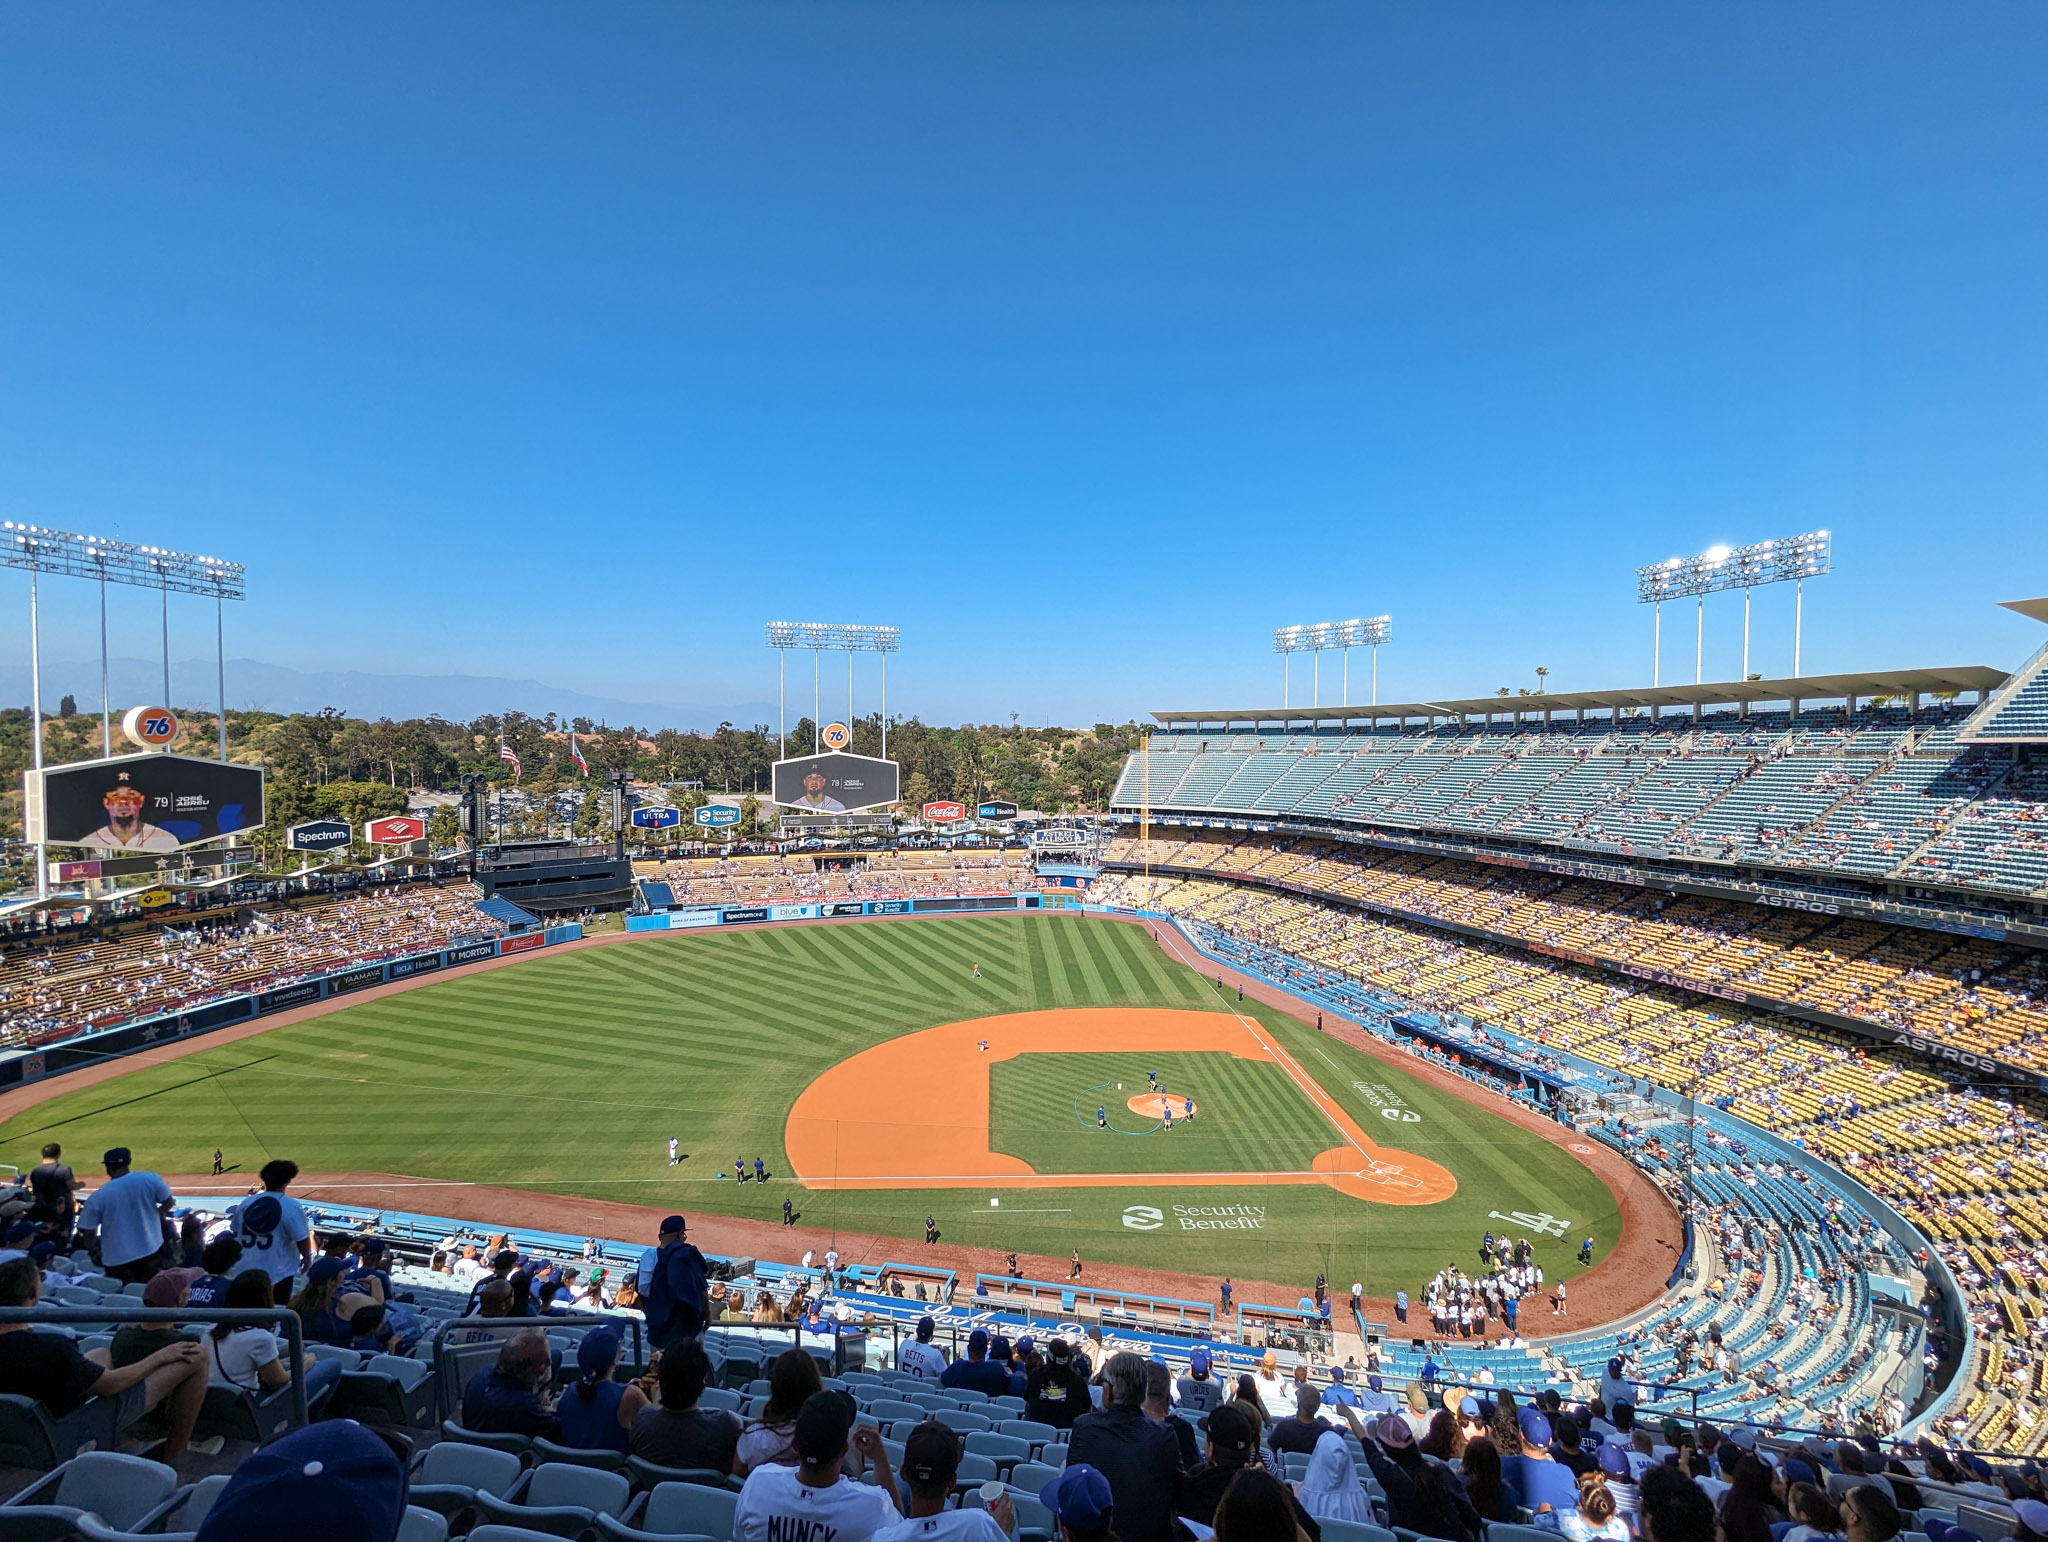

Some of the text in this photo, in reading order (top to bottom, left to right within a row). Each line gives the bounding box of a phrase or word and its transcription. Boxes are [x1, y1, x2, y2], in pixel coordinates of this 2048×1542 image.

[145, 718, 170, 736] 76
[829, 731, 844, 741] 76
[154, 797, 169, 808] 79
[642, 812, 670, 820] ULTRA
[712, 809, 736, 818] Security
[713, 815, 734, 823] Benefit
[298, 829, 346, 842] Spectrum
[1335, 835, 1363, 845] ASTROS
[1592, 845, 1618, 854] AMERICA
[1549, 865, 1646, 887] LOS ANGELES
[1279, 881, 1313, 895] ANGELES
[227, 897, 268, 908] ANGELES
[1359, 902, 1392, 915] ASTROS
[1755, 894, 1840, 915] ASTROS
[780, 907, 799, 917] blue
[458, 946, 491, 960] MORTON
[396, 958, 437, 973] UCLA Health
[1620, 964, 1654, 980] LOS
[1660, 974, 1748, 1003] ANGELES
[1893, 1034, 1997, 1074] ASTROS
[1172, 1203, 1266, 1217] Security
[1178, 1216, 1266, 1230] Benefit
[904, 1349, 926, 1363] BETTS
[1580, 1437, 1598, 1449] ETTS
[767, 1515, 838, 1542] MUNCY
